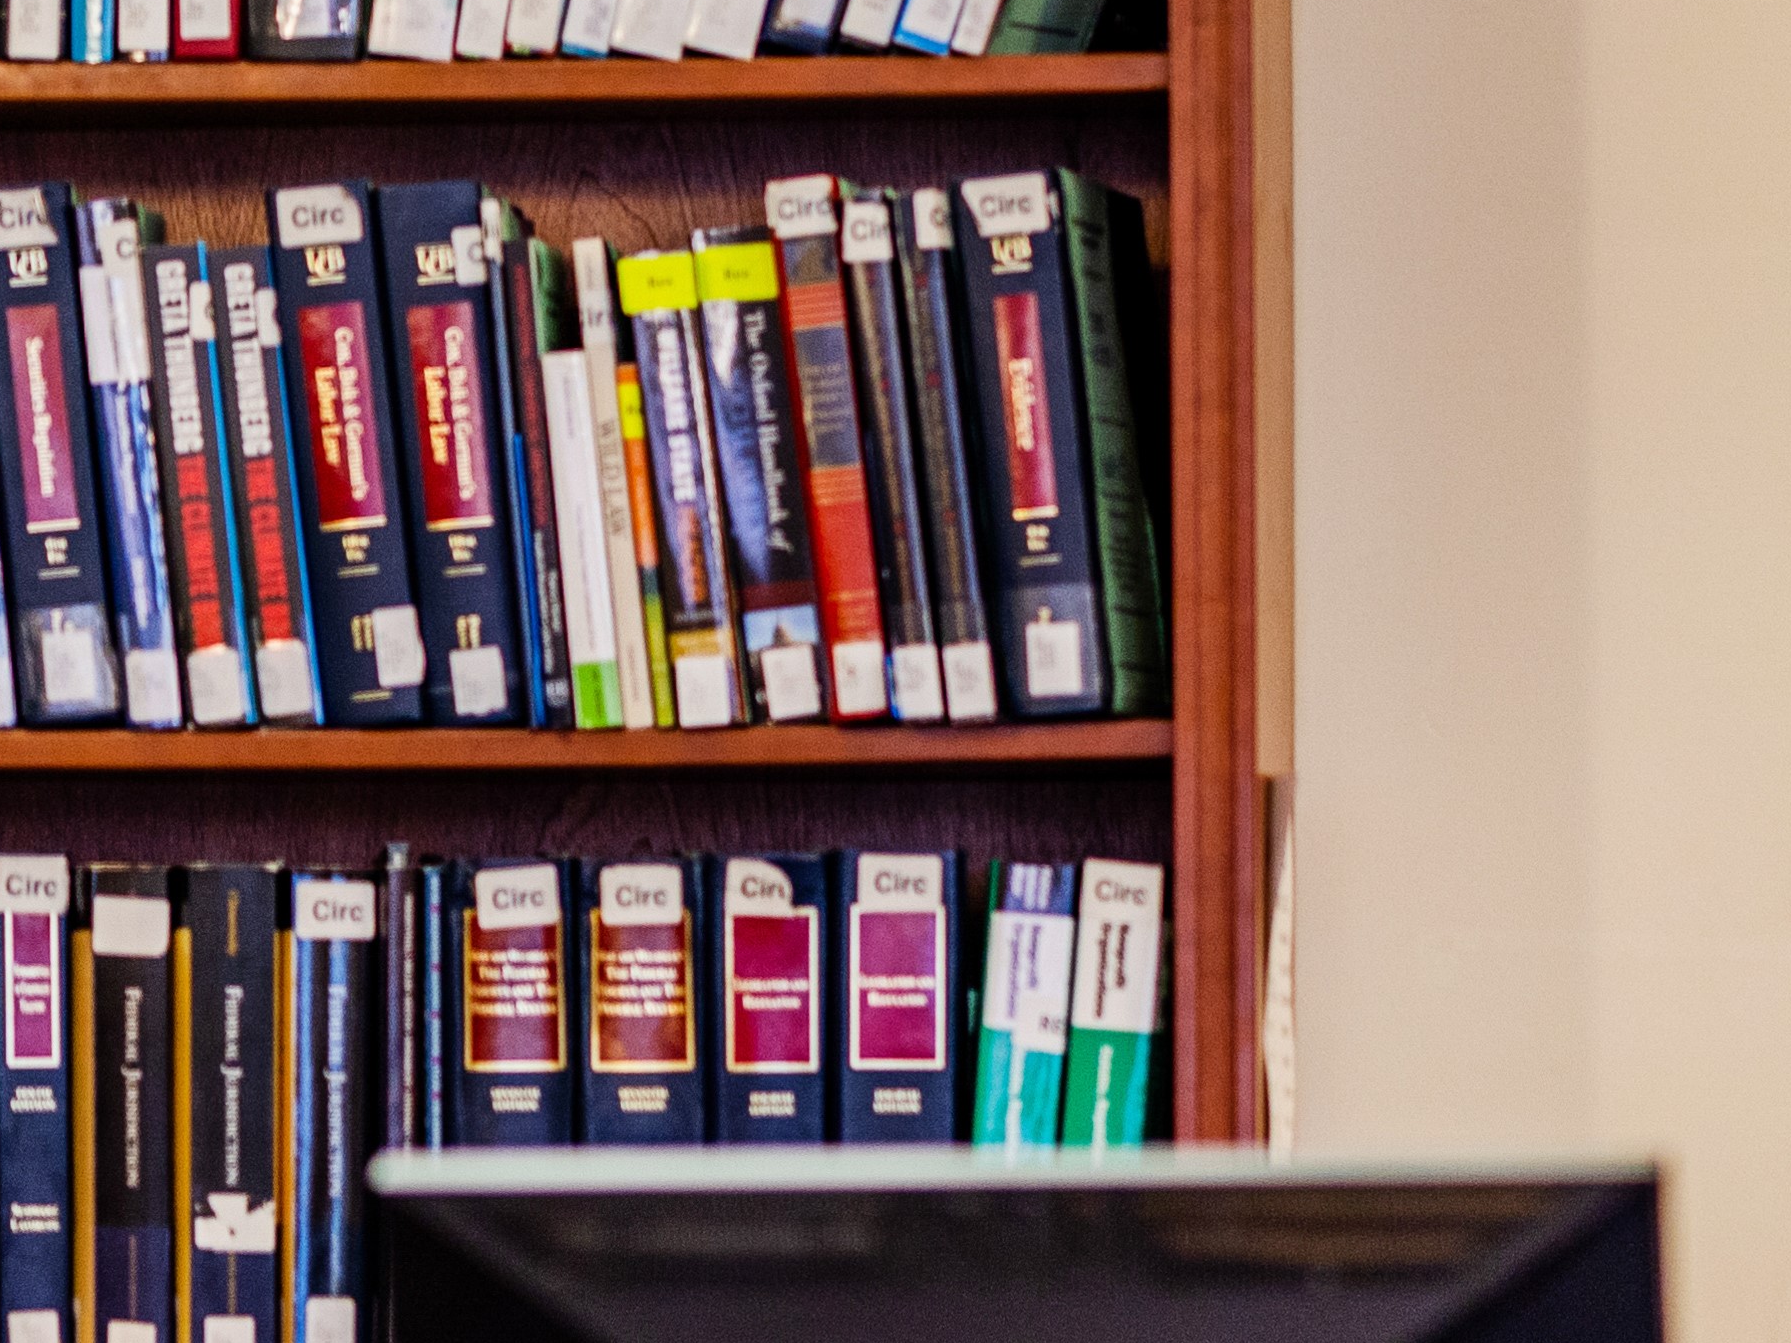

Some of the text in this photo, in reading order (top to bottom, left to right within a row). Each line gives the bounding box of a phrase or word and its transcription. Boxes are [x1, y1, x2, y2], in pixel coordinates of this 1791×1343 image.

[292, 206, 345, 228] Circ
[980, 195, 1029, 218] Circ
[156, 259, 204, 455] GRETA THUNBERG
[224, 262, 272, 456] GRETA THUNBERG
[743, 310, 794, 553] The Oxford Handbook of
[666, 433, 696, 503] STATE
[5, 876, 56, 897] Circ
[873, 871, 927, 894] Circ
[1095, 879, 1147, 904] Circ
[492, 885, 544, 910] Circ
[614, 883, 667, 907] Circ
[313, 901, 362, 921] Circ
